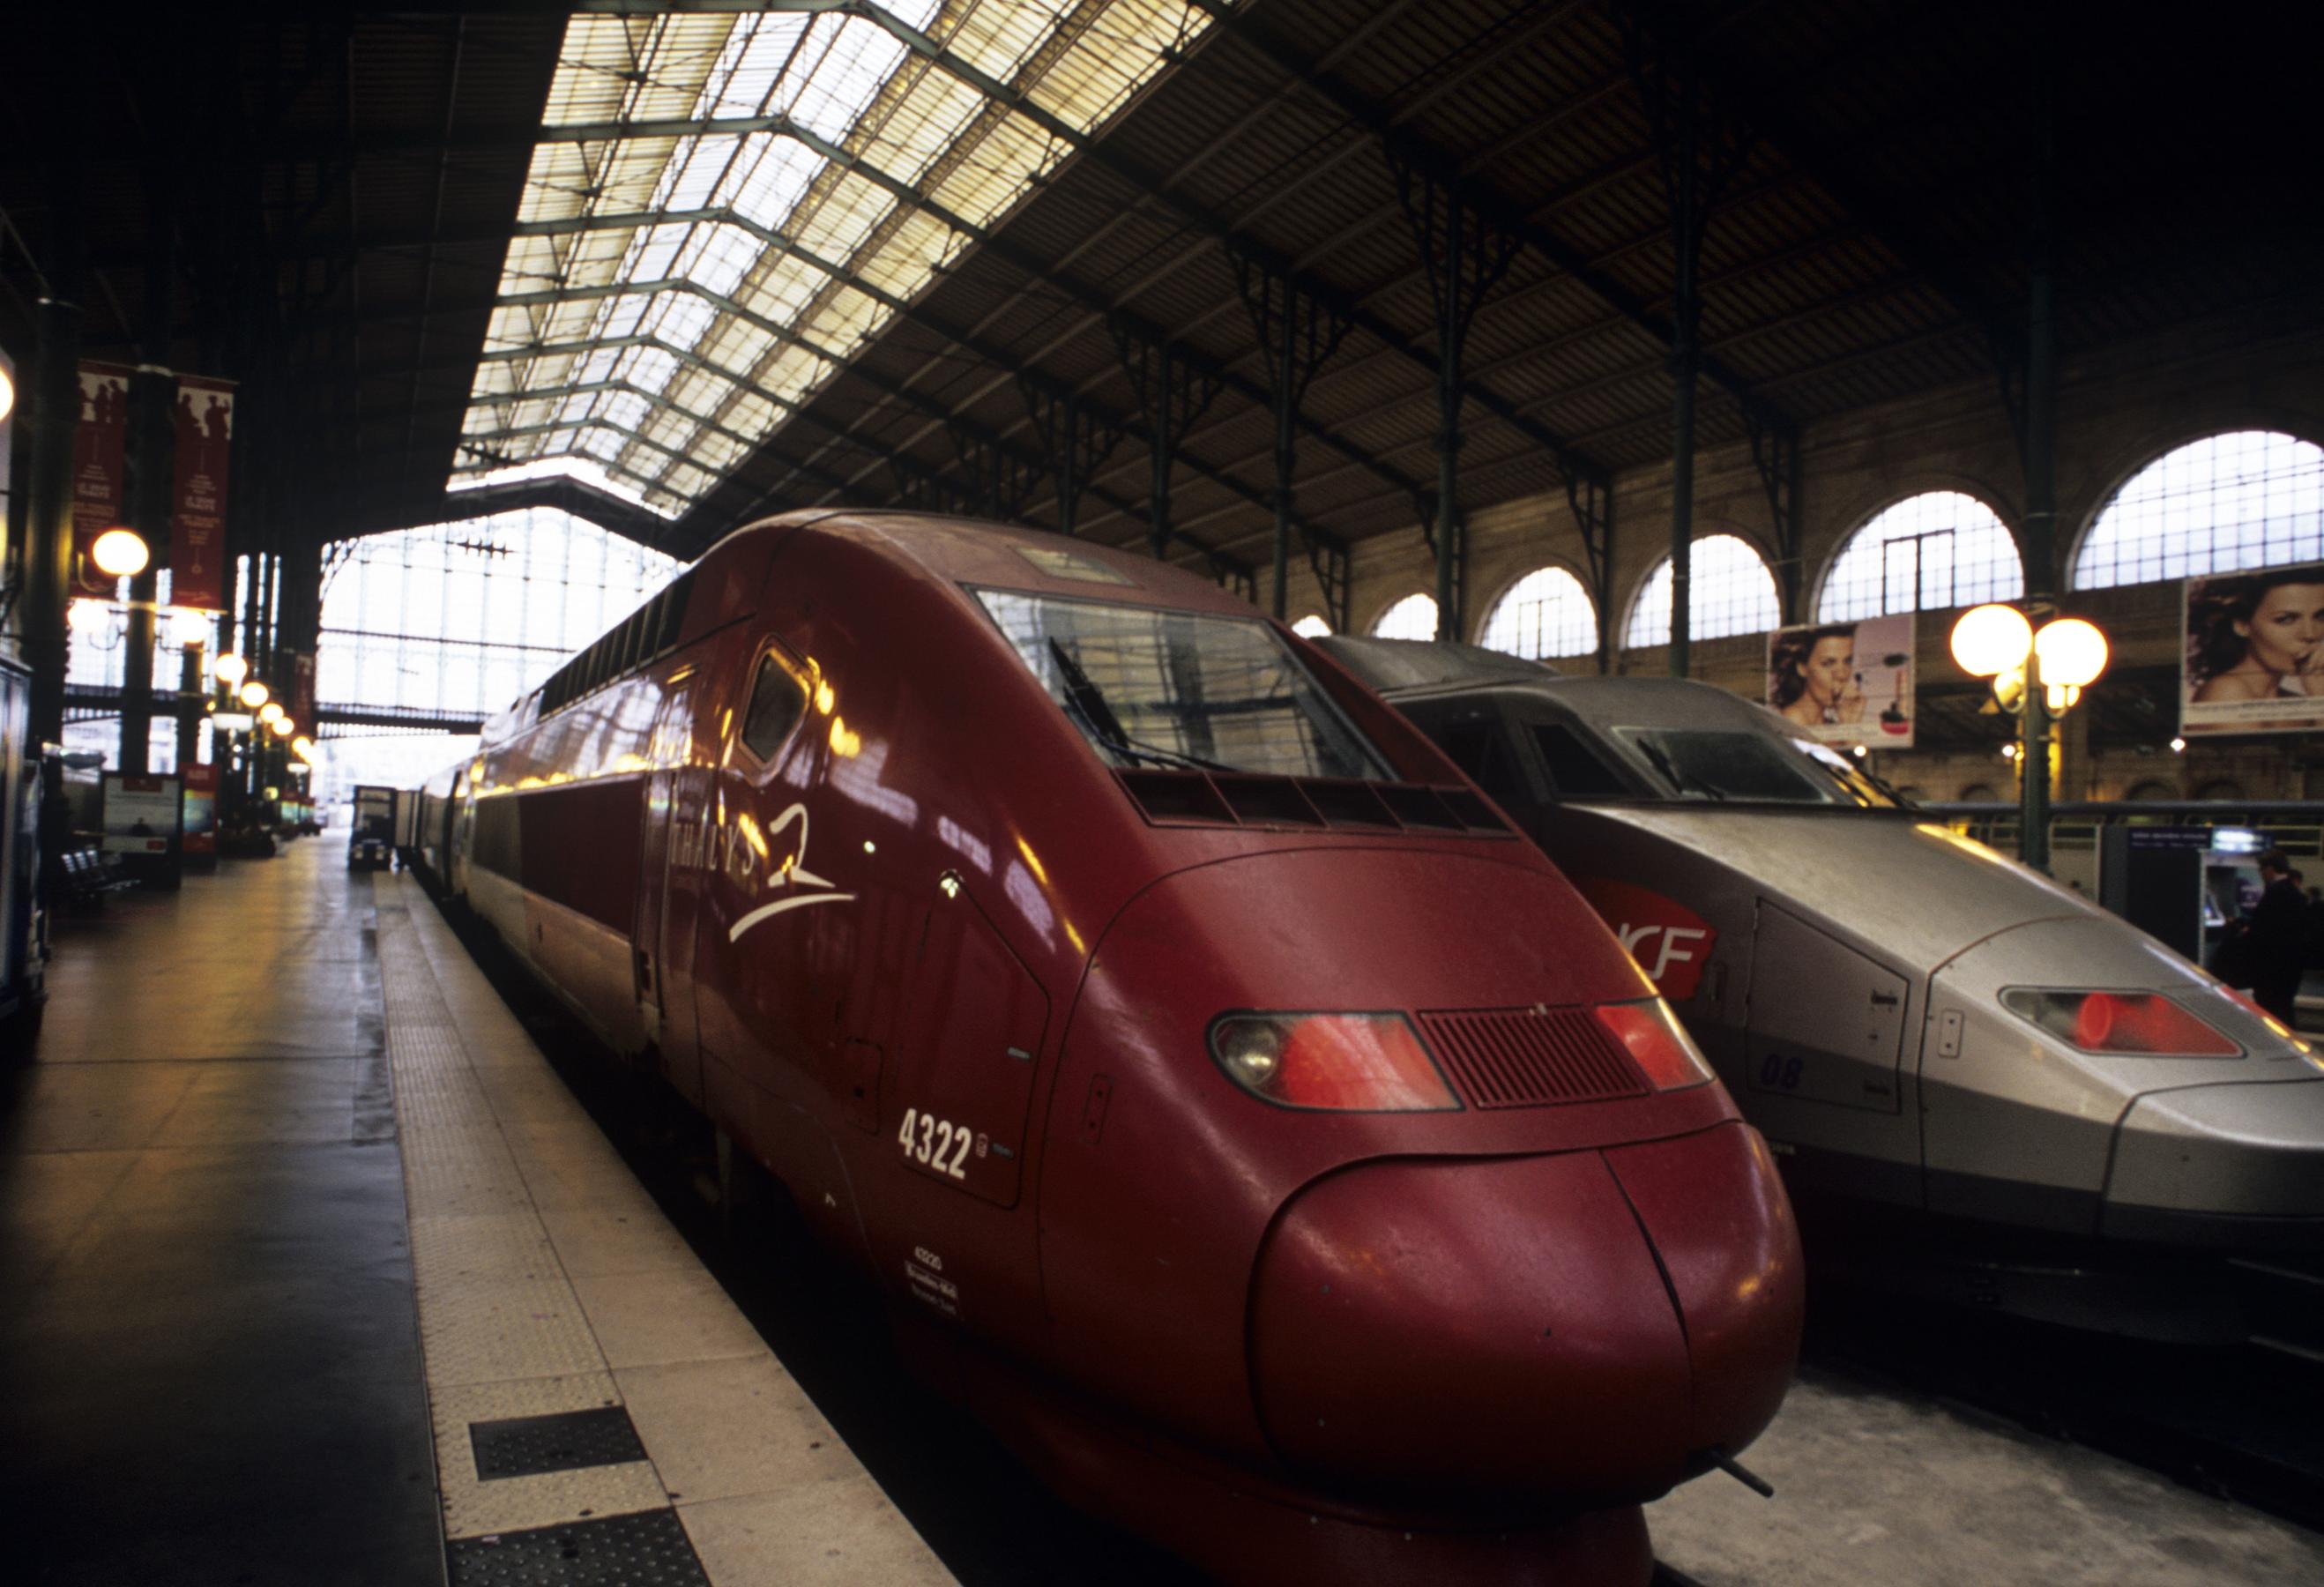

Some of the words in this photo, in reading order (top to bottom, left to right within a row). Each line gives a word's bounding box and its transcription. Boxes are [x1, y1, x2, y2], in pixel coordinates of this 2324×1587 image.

[1619, 922, 1707, 980] CF
[1761, 1053, 1803, 1089] 08
[898, 1107, 972, 1180] 4322
